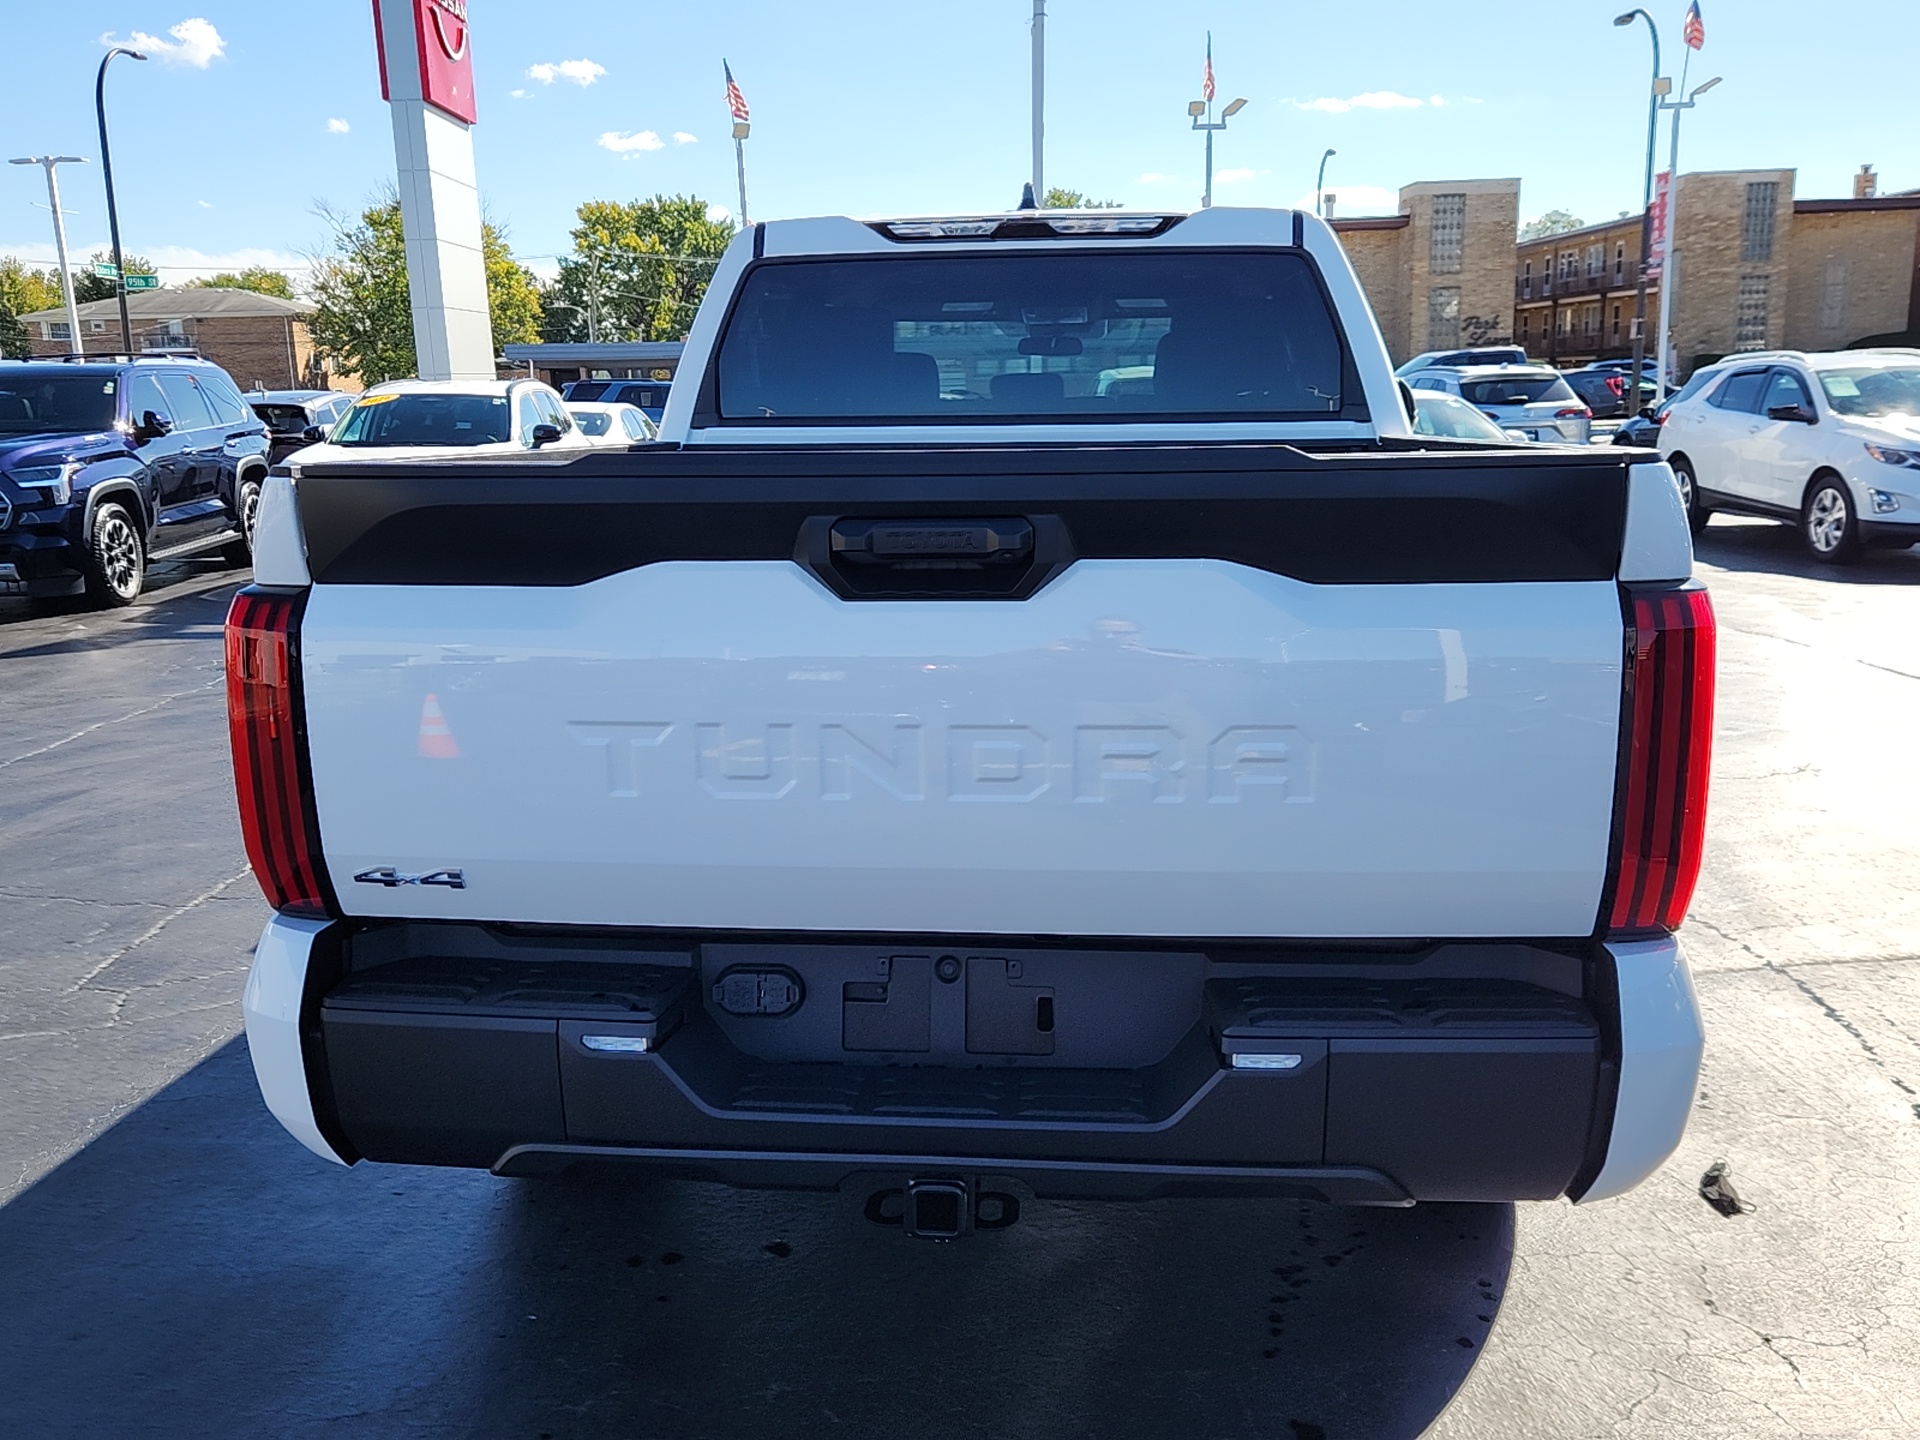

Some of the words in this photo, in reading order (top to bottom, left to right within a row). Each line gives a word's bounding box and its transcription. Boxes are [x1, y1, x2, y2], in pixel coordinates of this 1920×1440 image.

[435, 0, 469, 22] SSAN
[128, 278, 146, 287] 95th
[148, 278, 157, 287] St
[1461, 314, 1500, 331] Park
[885, 531, 978, 550] TOYOTA
[566, 719, 1318, 804] TUNDRA
